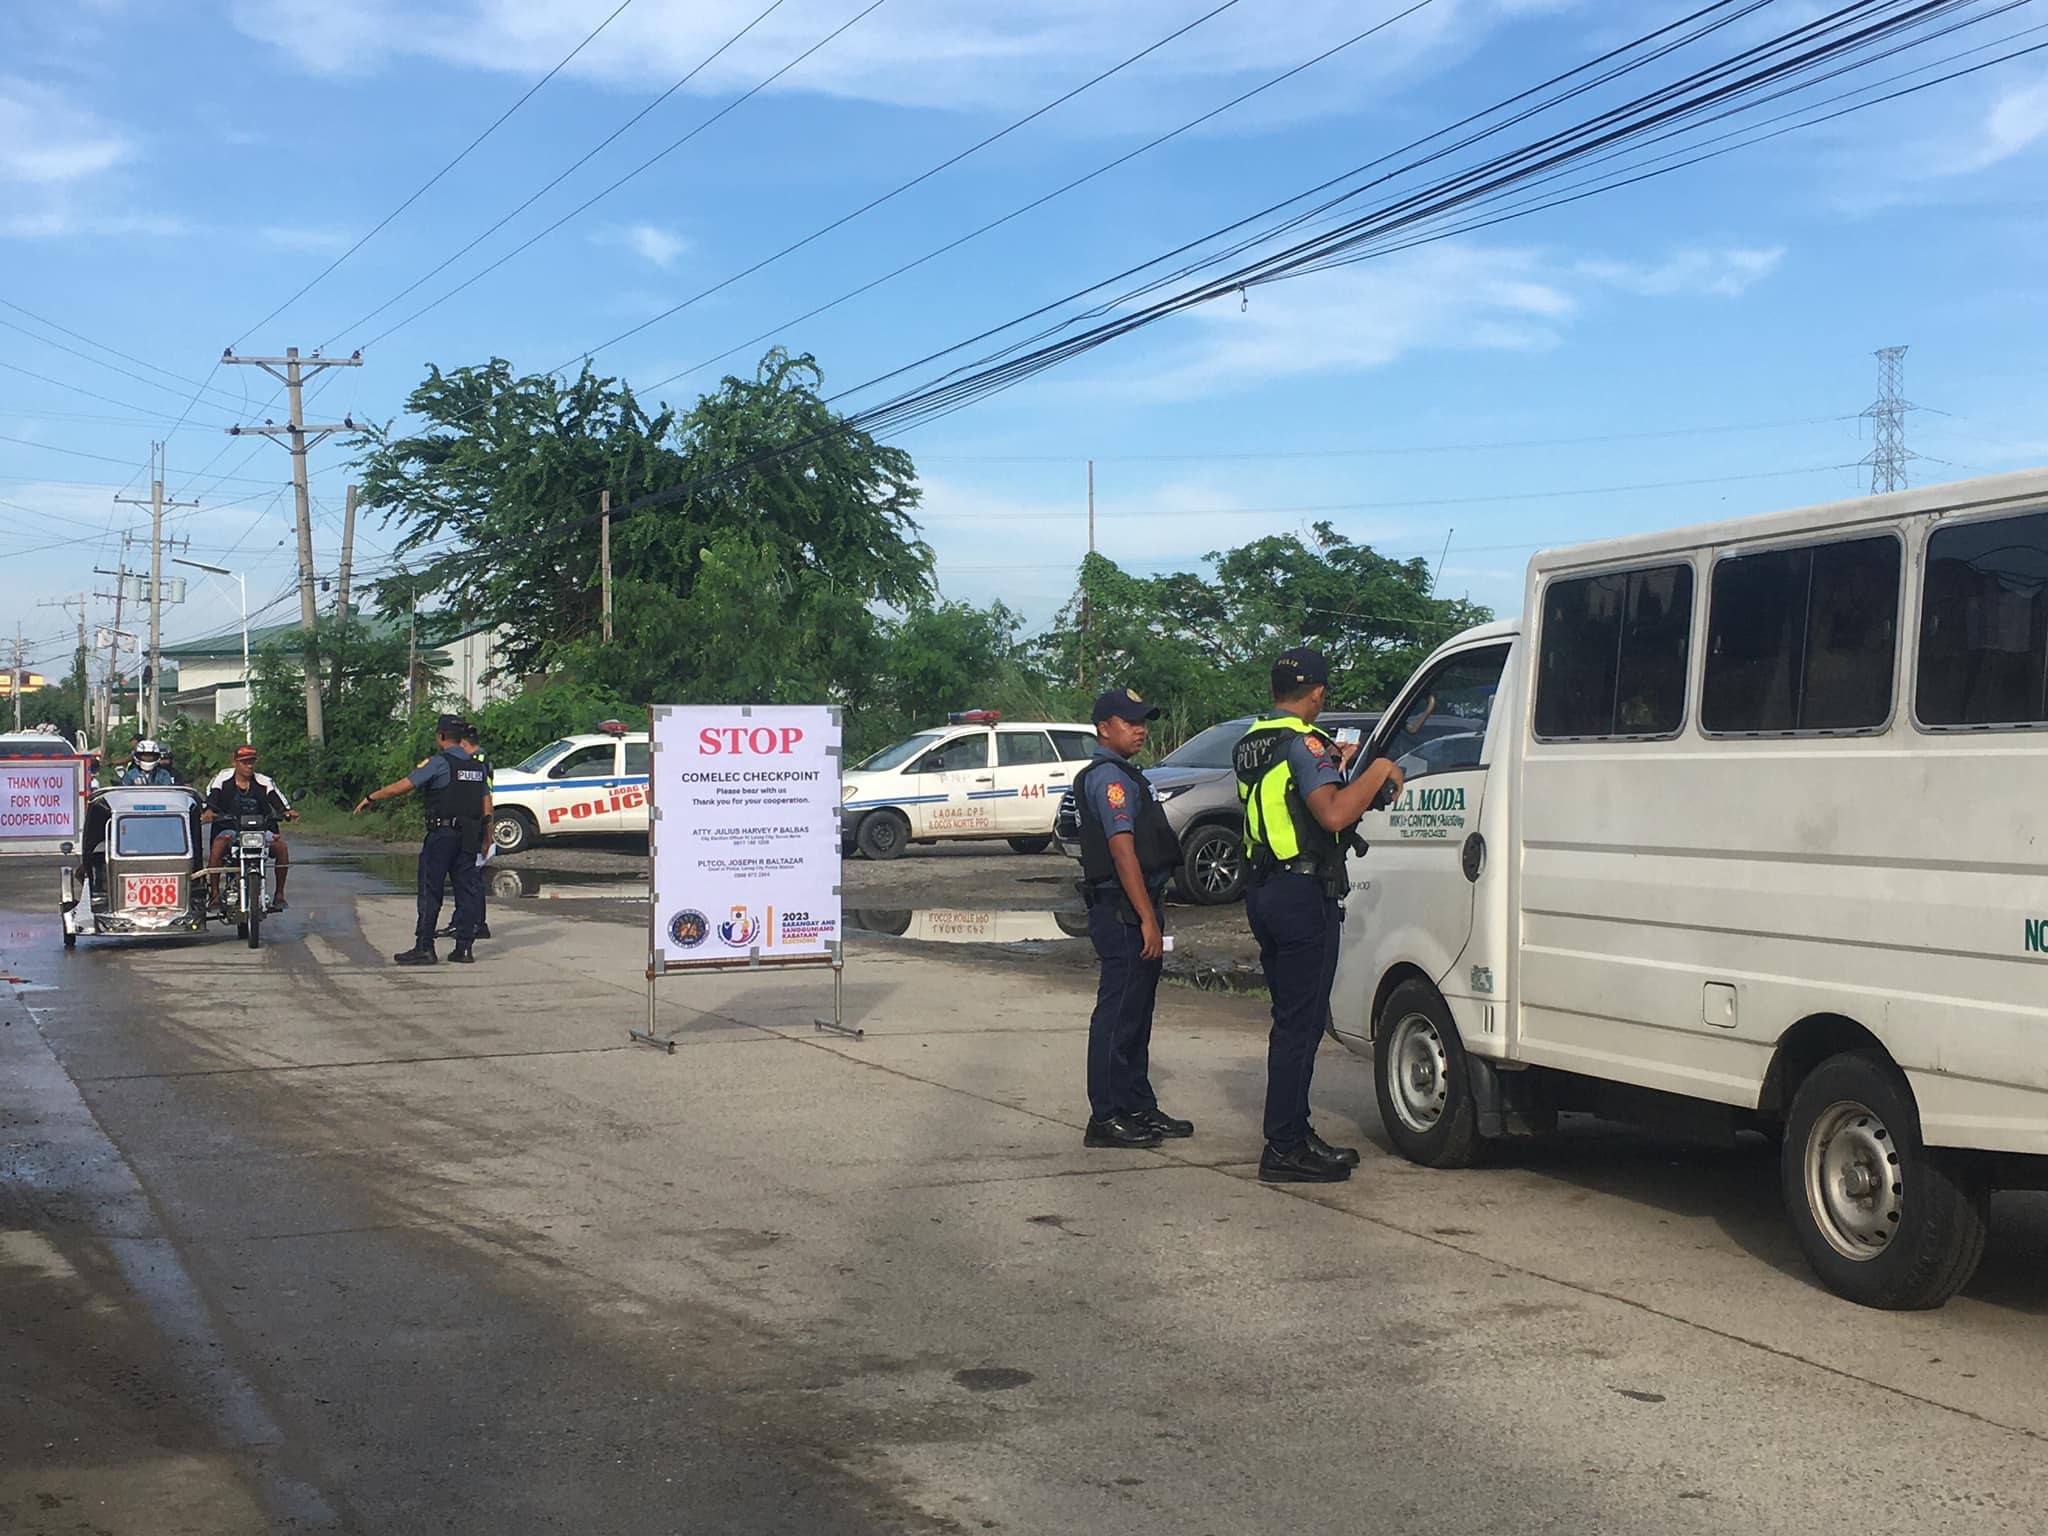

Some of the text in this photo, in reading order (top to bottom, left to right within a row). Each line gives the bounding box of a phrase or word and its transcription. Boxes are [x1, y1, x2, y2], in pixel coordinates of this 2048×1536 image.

[699, 728, 803, 755] STOP
[8, 776, 63, 789] THANK YOU
[681, 771, 820, 782] COMELEC CHECKPOINT
[1020, 784, 1045, 799] 441
[10, 795, 60, 808] FOR YOUR
[1392, 788, 1466, 812] LA MODA
[1, 813, 70, 826] COOPERATION
[766, 857, 804, 865] BALTAZAR
[138, 885, 177, 906] 038
[782, 912, 809, 921] 2023
